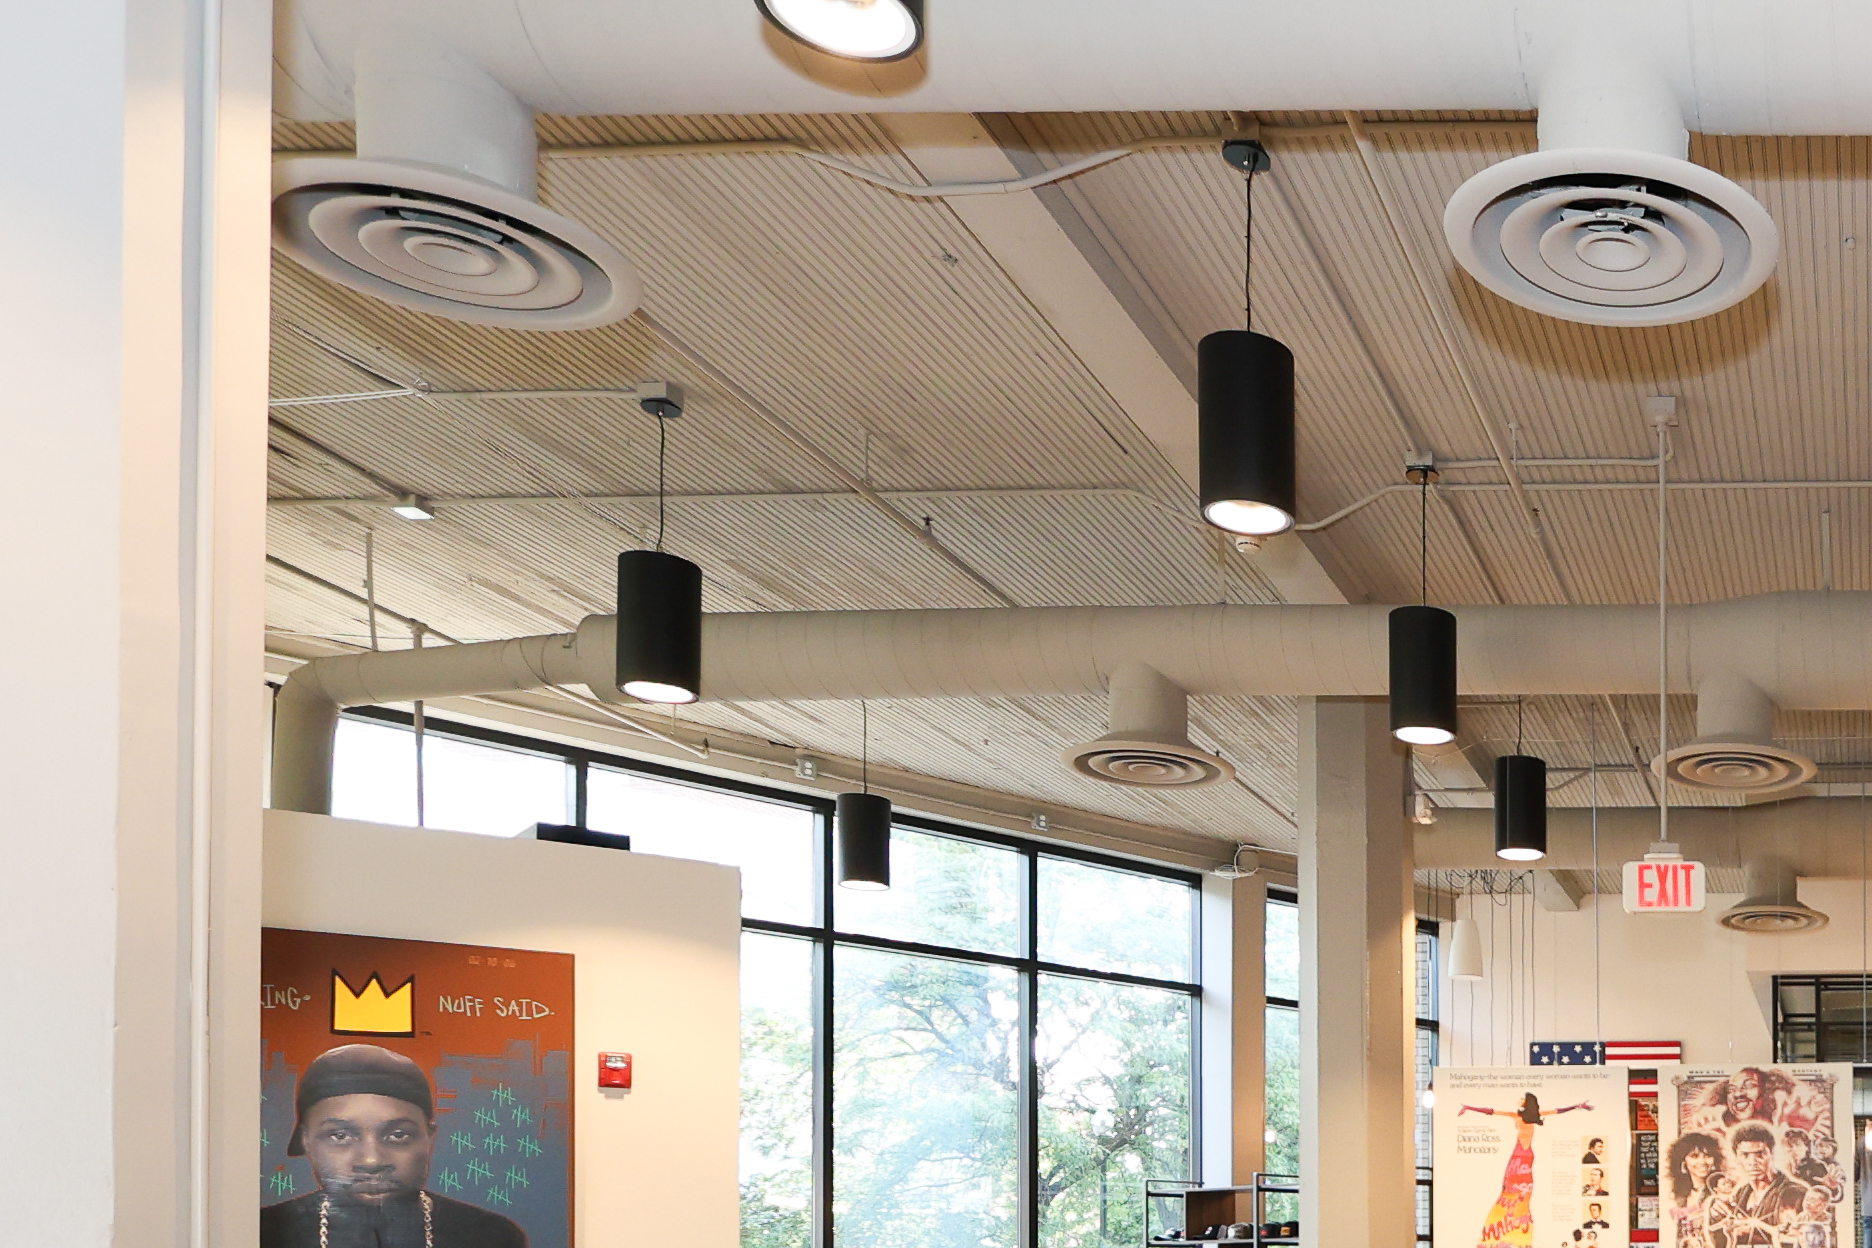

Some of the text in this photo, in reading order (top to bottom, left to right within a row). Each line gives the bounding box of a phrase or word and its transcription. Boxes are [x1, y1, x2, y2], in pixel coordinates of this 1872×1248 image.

[1637, 863, 1696, 907] EXIT
[439, 995, 555, 1020] NUFF SAID.
[1457, 1133, 1501, 1143] Diana Ross
